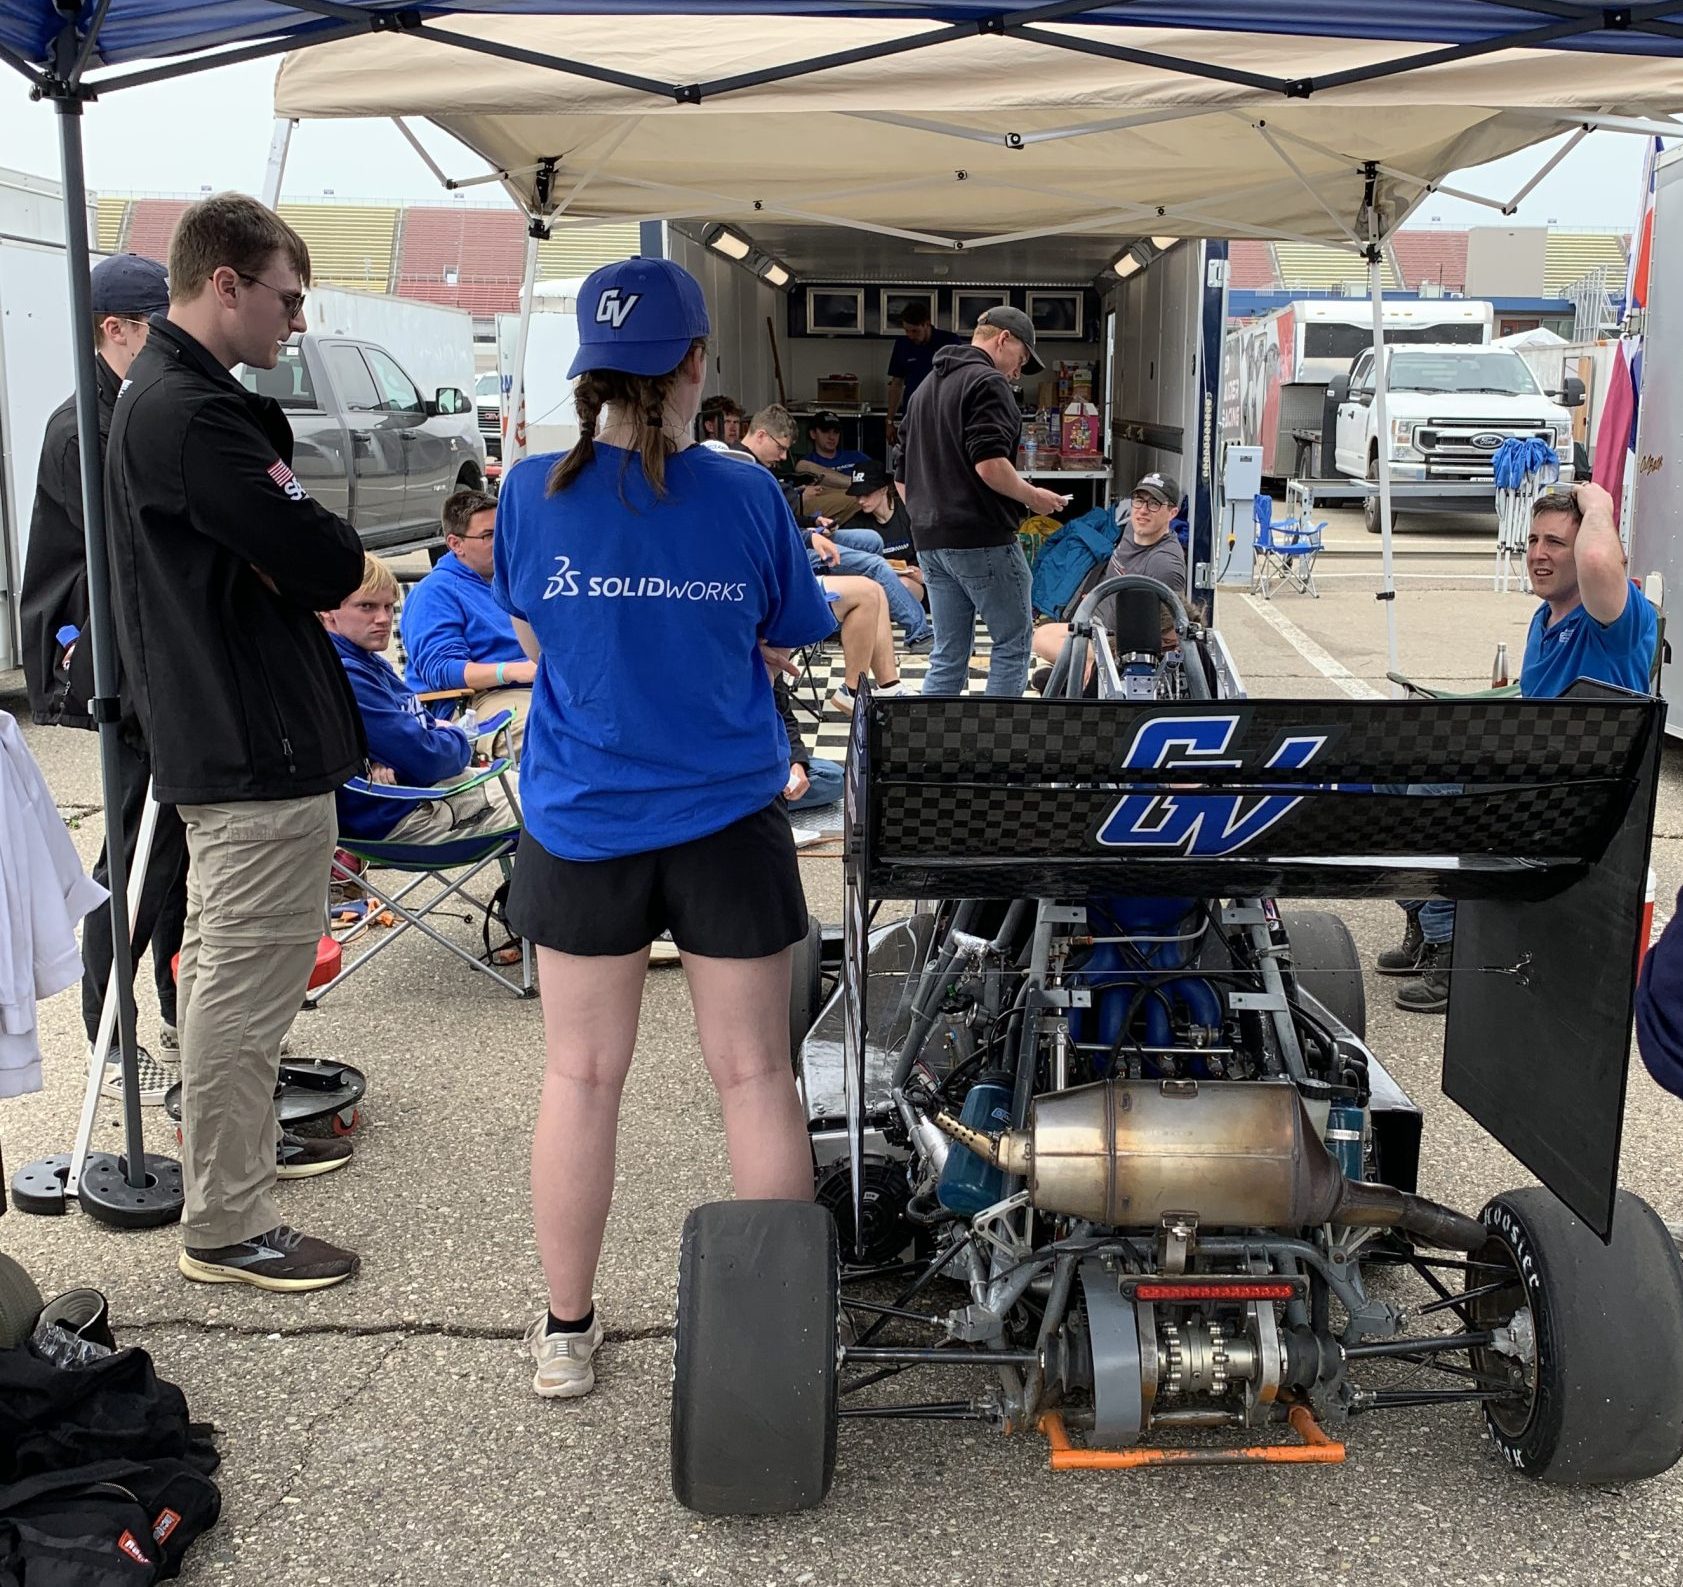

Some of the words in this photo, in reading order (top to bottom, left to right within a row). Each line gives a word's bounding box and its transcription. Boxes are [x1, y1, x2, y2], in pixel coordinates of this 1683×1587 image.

[595, 287, 640, 328] GV
[588, 577, 747, 602] SOLIDWORKS
[1096, 715, 1328, 857] GV
